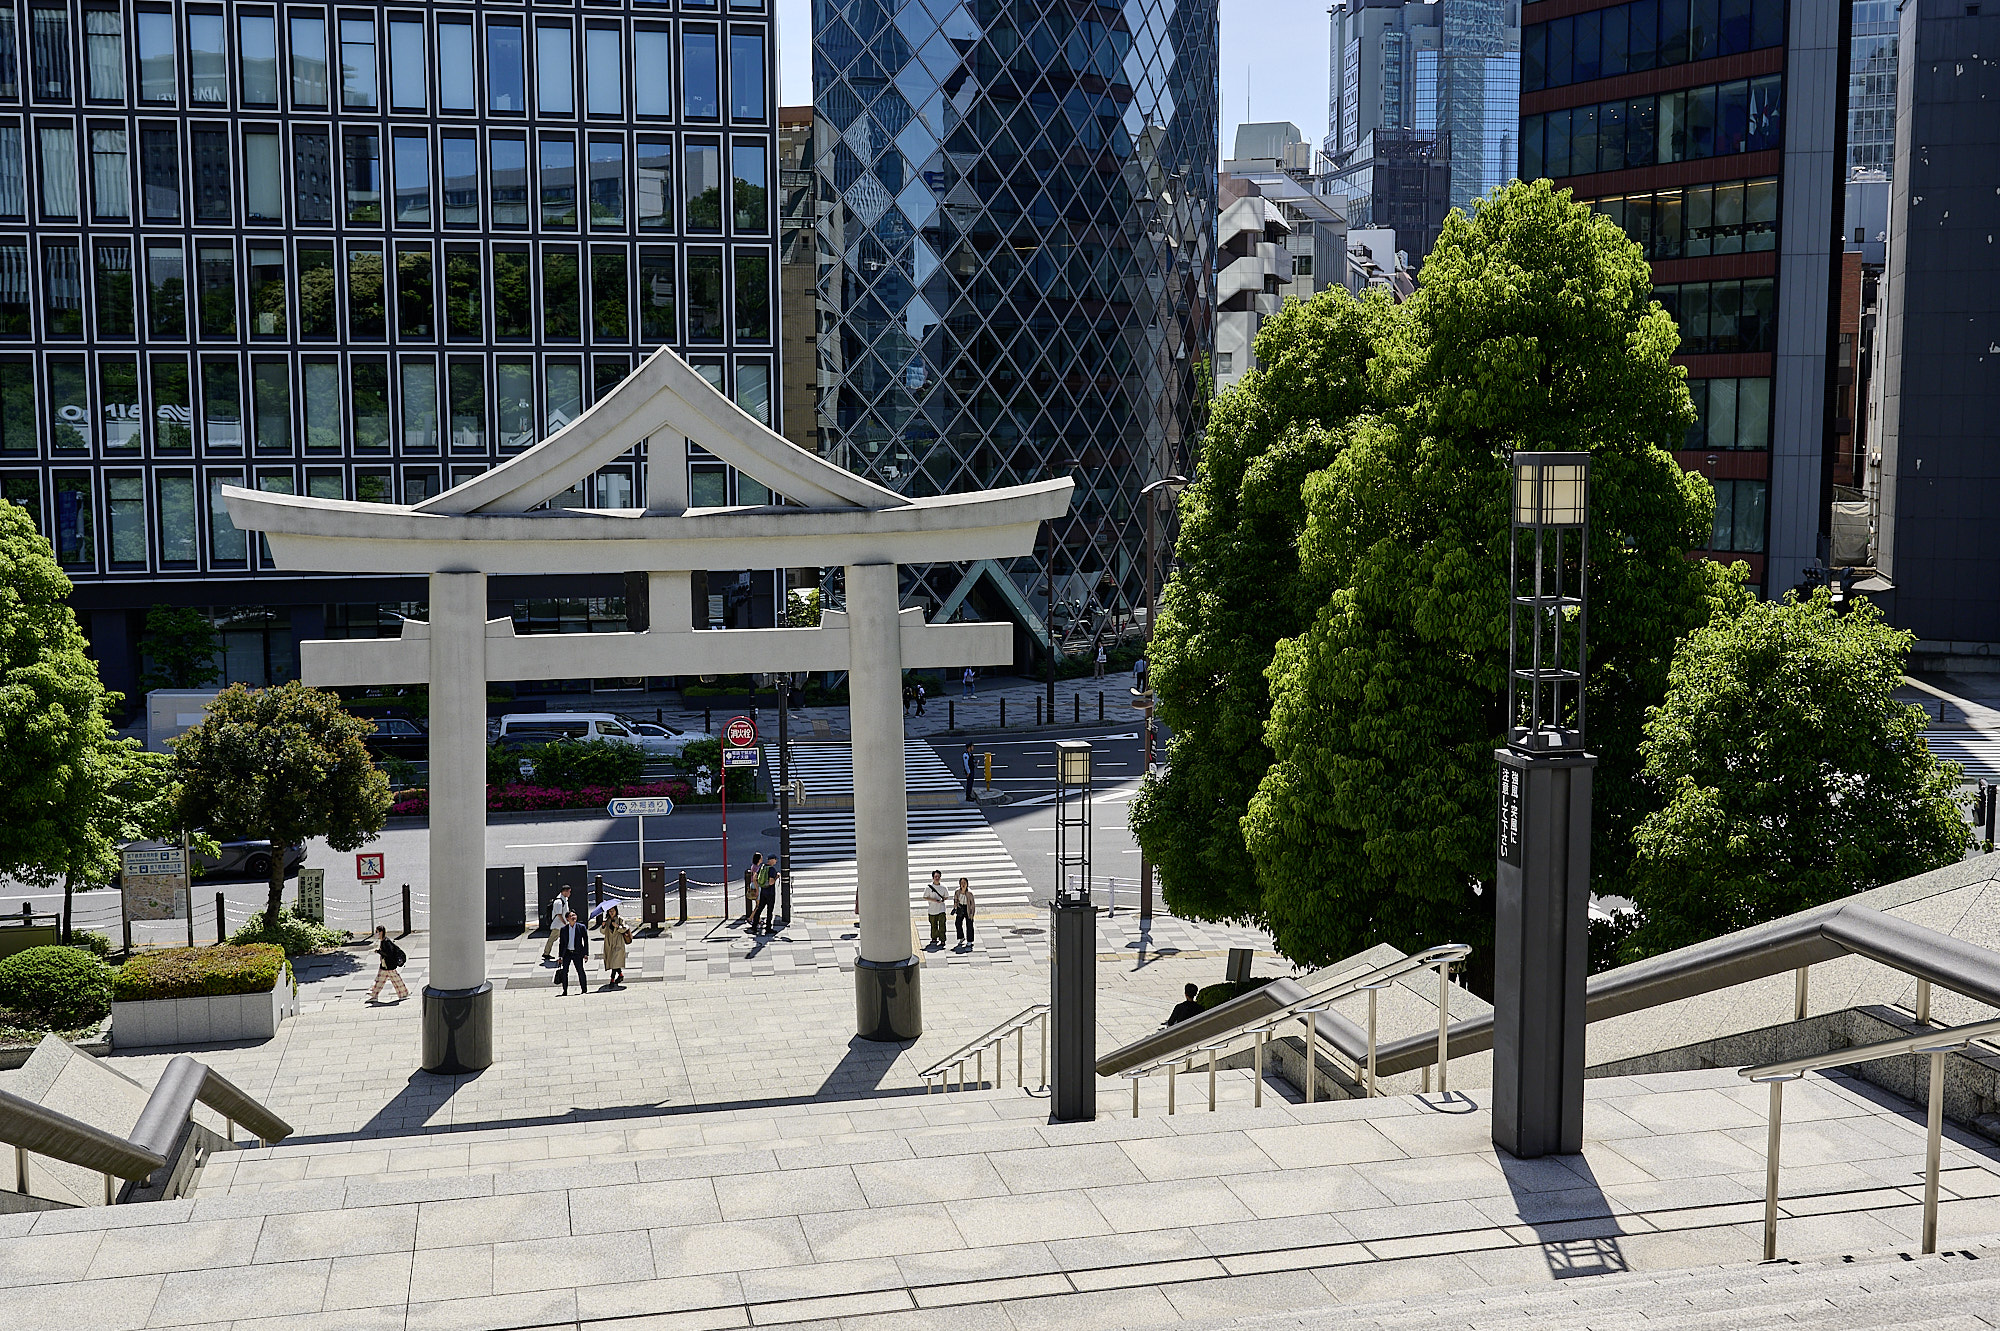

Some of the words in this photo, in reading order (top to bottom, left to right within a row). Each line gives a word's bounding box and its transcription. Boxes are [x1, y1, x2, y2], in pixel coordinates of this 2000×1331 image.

[731, 728, 751, 739] 消火栓
[630, 800, 663, 809] 外堀通り
[1501, 767, 1509, 857] 注意して下さい
[1510, 770, 1519, 844] 強風・突風に
